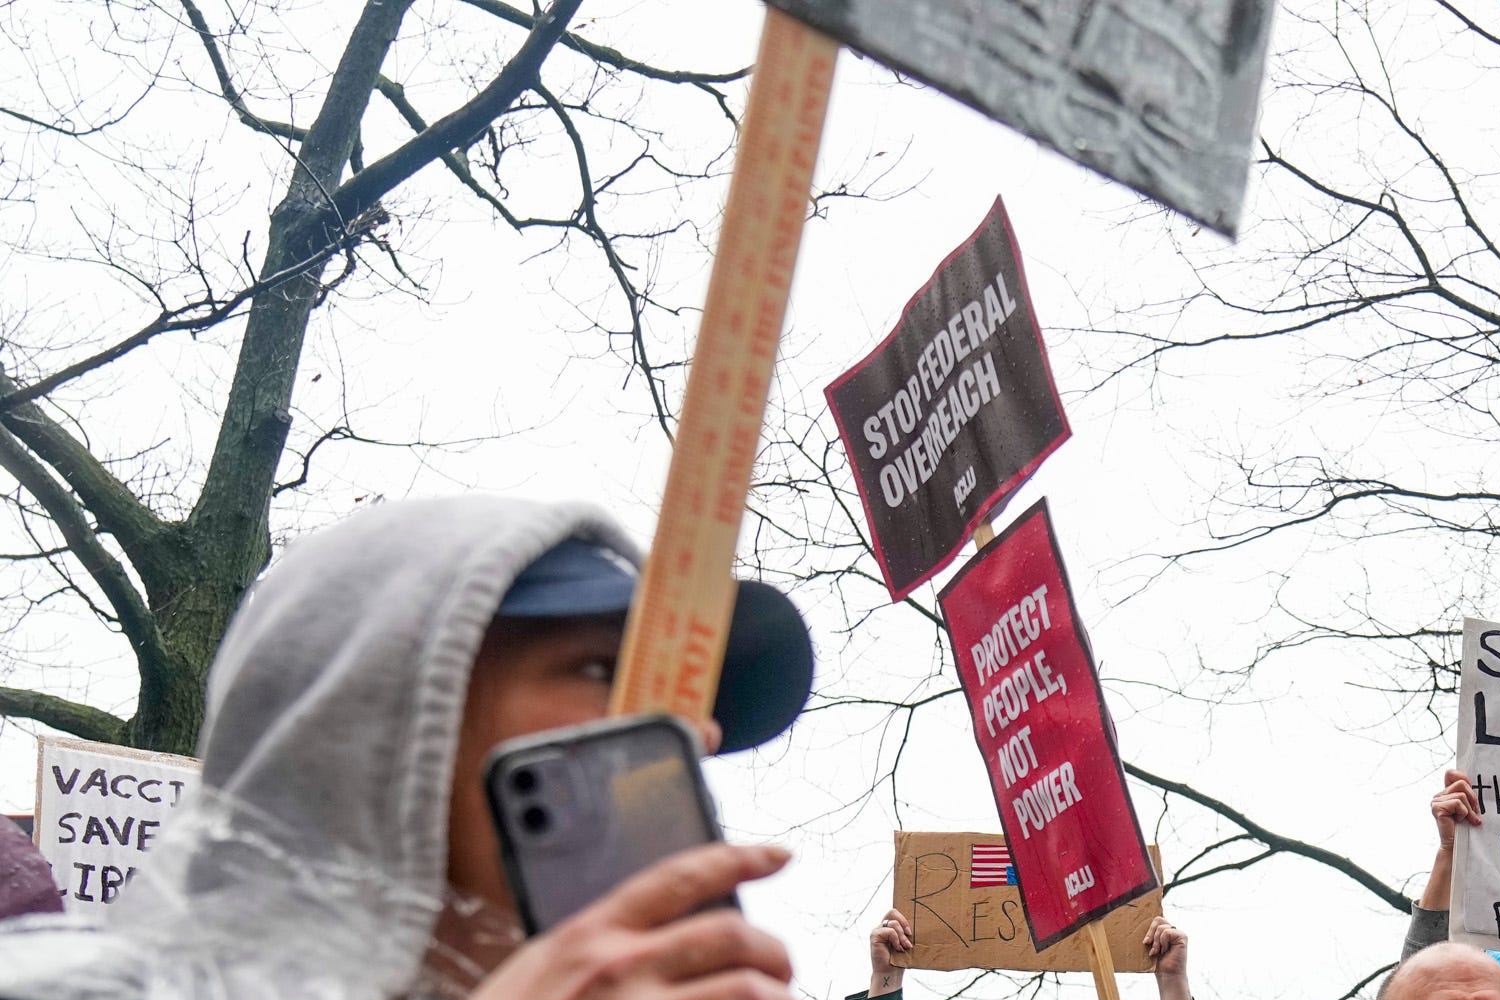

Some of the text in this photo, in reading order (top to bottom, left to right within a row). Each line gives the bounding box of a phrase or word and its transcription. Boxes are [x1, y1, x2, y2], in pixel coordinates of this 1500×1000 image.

[863, 272, 1017, 460] STOP FEDERAL
[879, 353, 1001, 508] OVERREACH
[953, 465, 977, 509] ACLU
[971, 584, 1050, 686] PROTECT
[983, 649, 1067, 738] PEOPLE,
[998, 725, 1039, 789] NOT
[1013, 761, 1083, 840] POWER
[1064, 864, 1095, 900] ACLU
